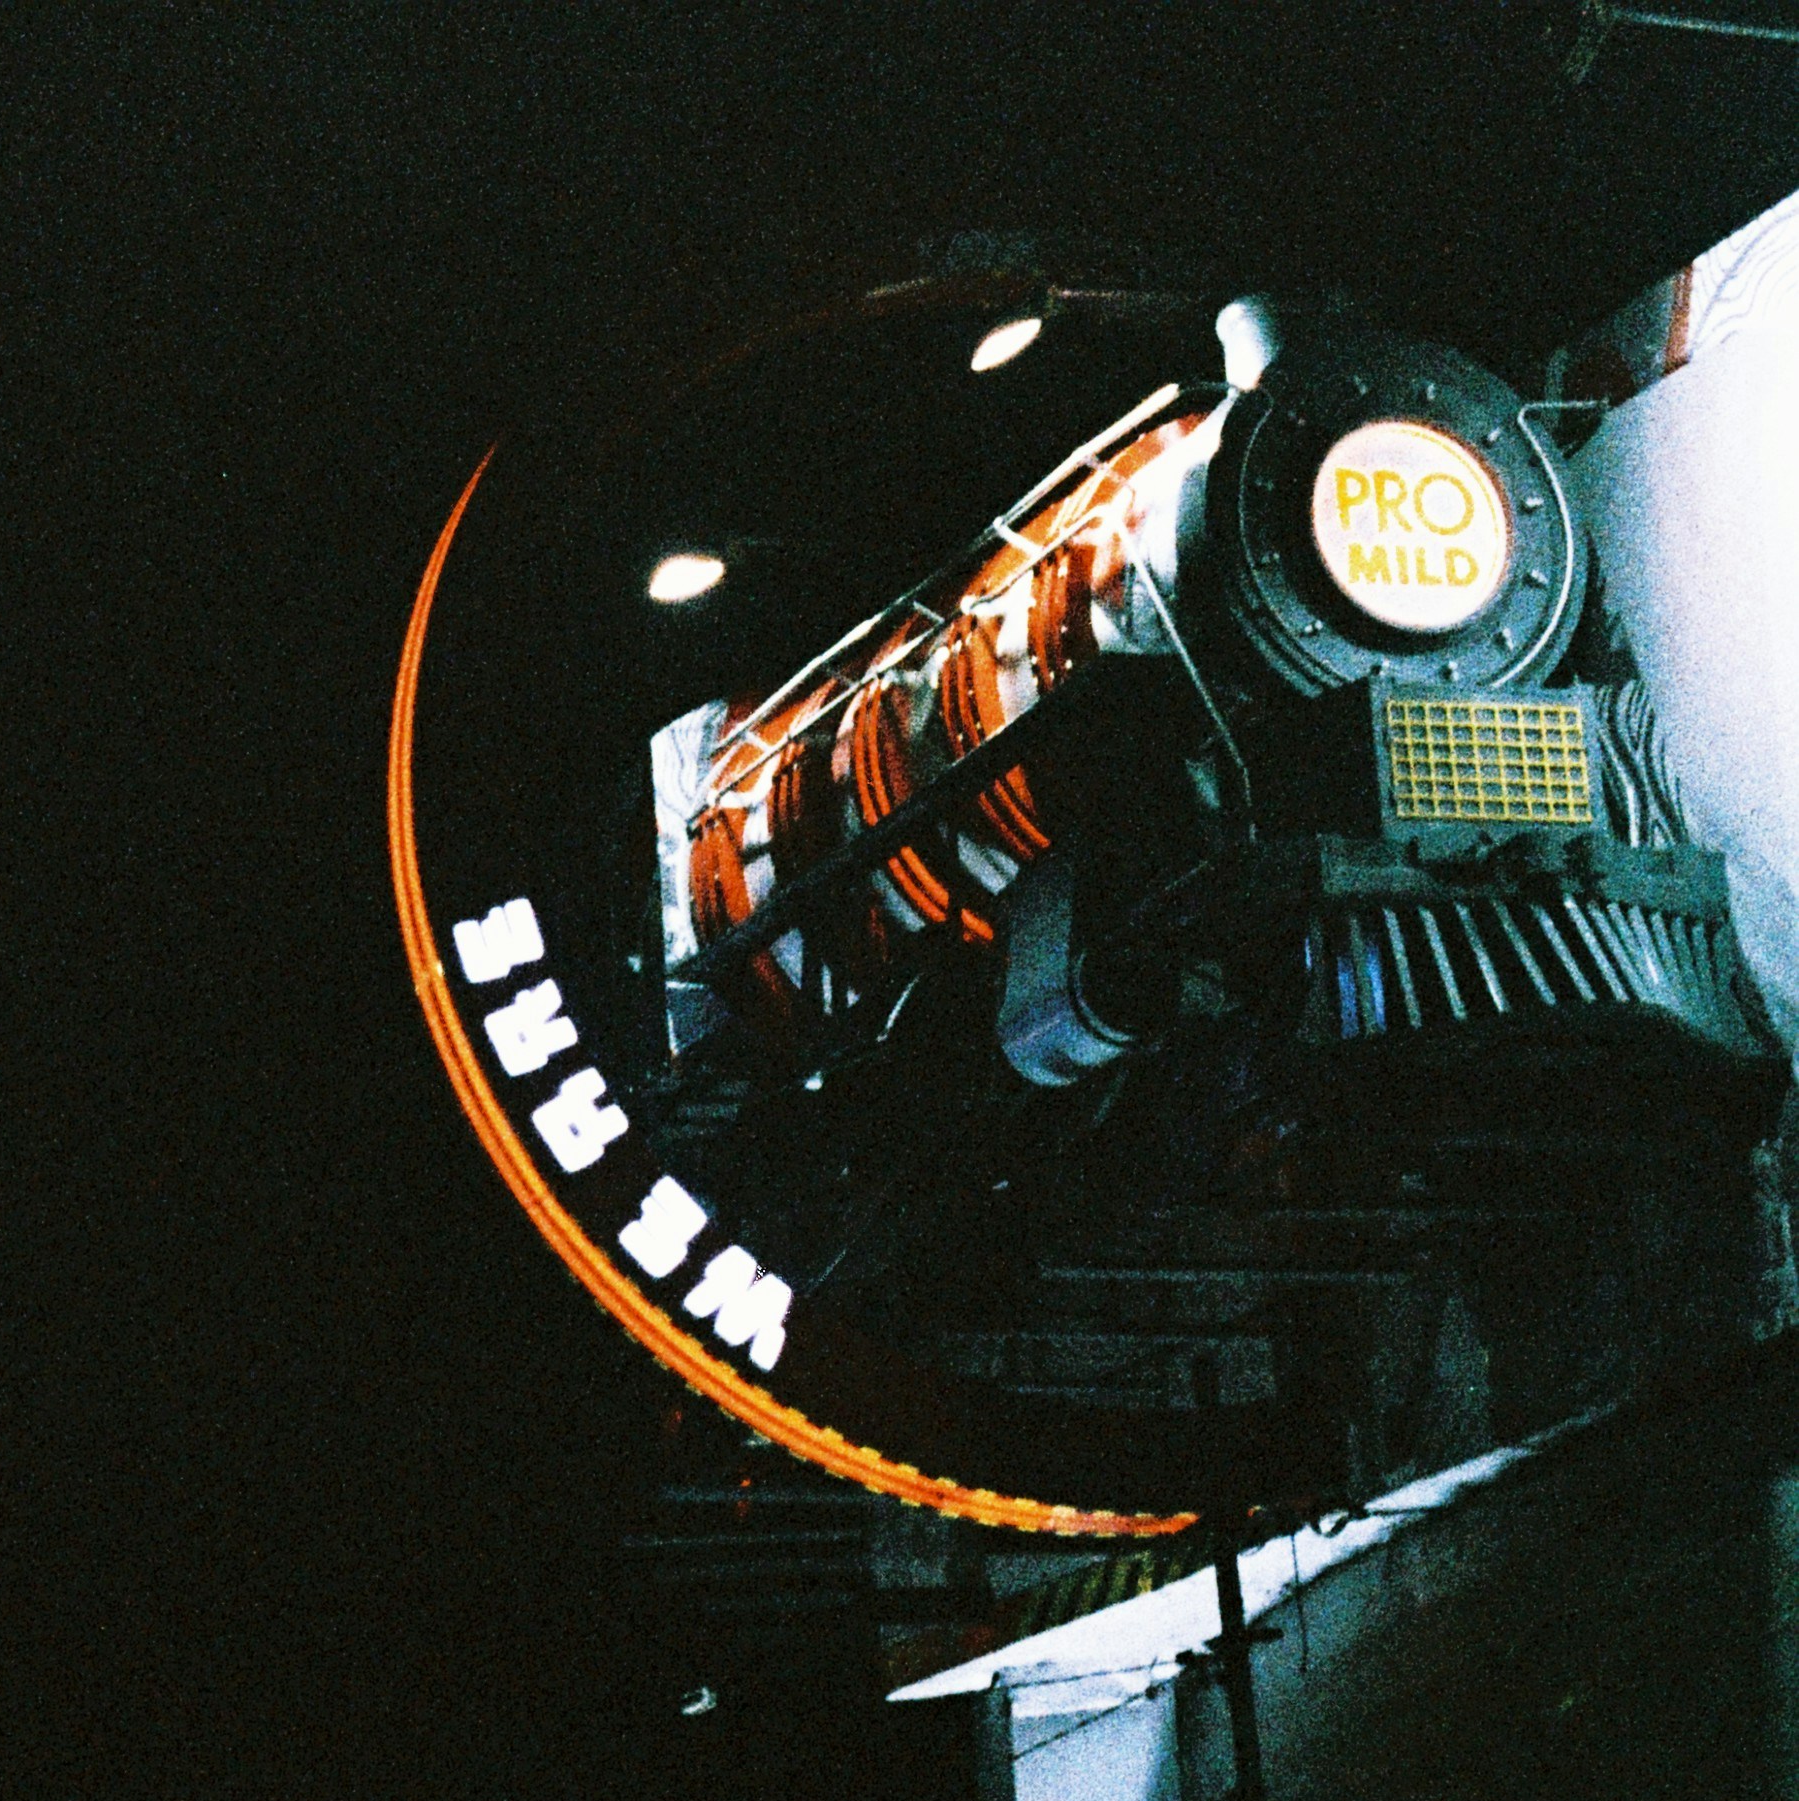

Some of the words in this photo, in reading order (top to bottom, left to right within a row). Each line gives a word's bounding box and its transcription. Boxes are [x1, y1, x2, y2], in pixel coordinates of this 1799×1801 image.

[1335, 468, 1474, 535] PRO
[1348, 543, 1479, 587] MILD
[453, 898, 629, 1173] ARE
[619, 1175, 792, 1371] WE
